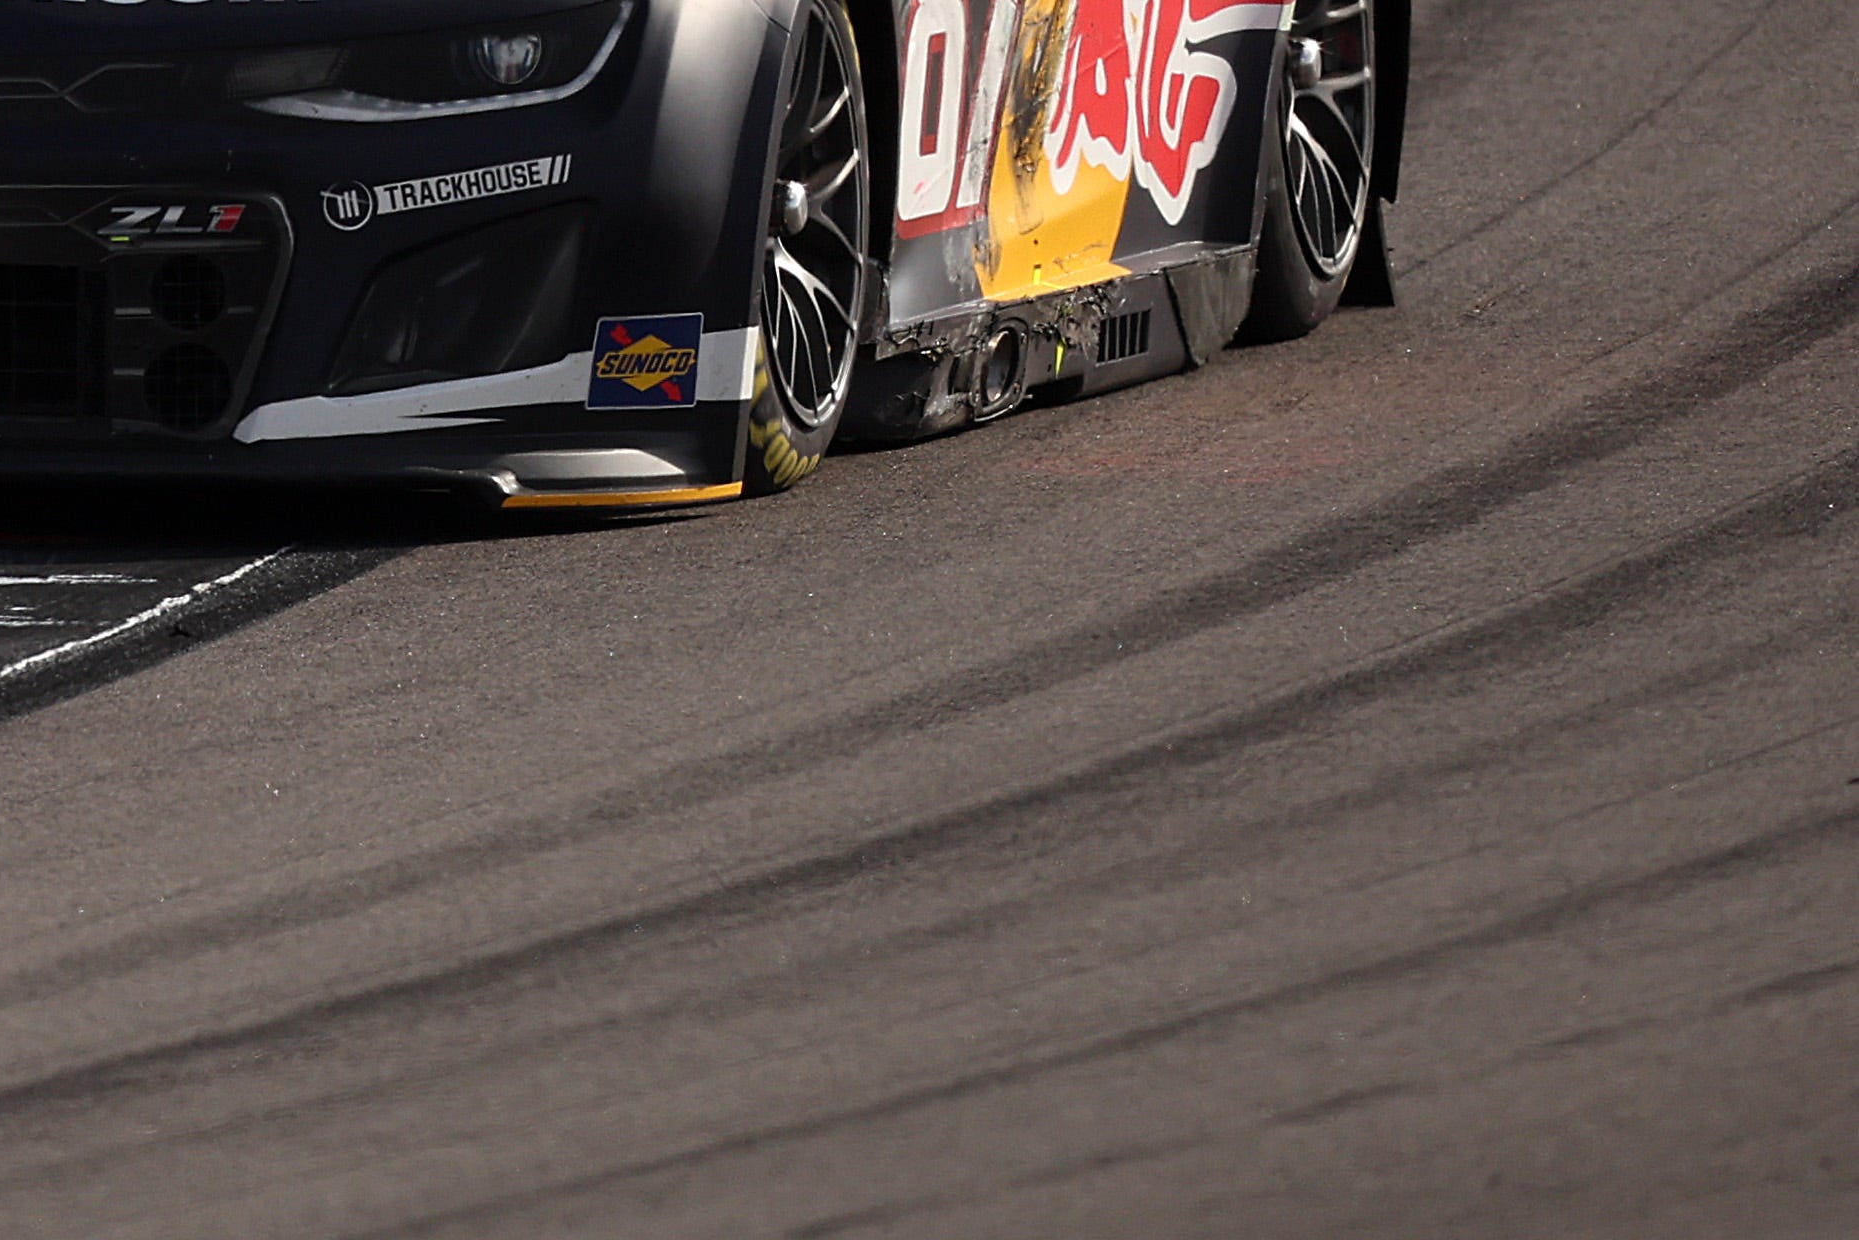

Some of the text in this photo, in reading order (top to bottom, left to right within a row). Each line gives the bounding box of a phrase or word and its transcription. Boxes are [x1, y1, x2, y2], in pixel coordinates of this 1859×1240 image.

[384, 162, 542, 210] TRACKHOUSE
[97, 204, 246, 235] ZL1
[600, 351, 691, 376] SUNOCO
